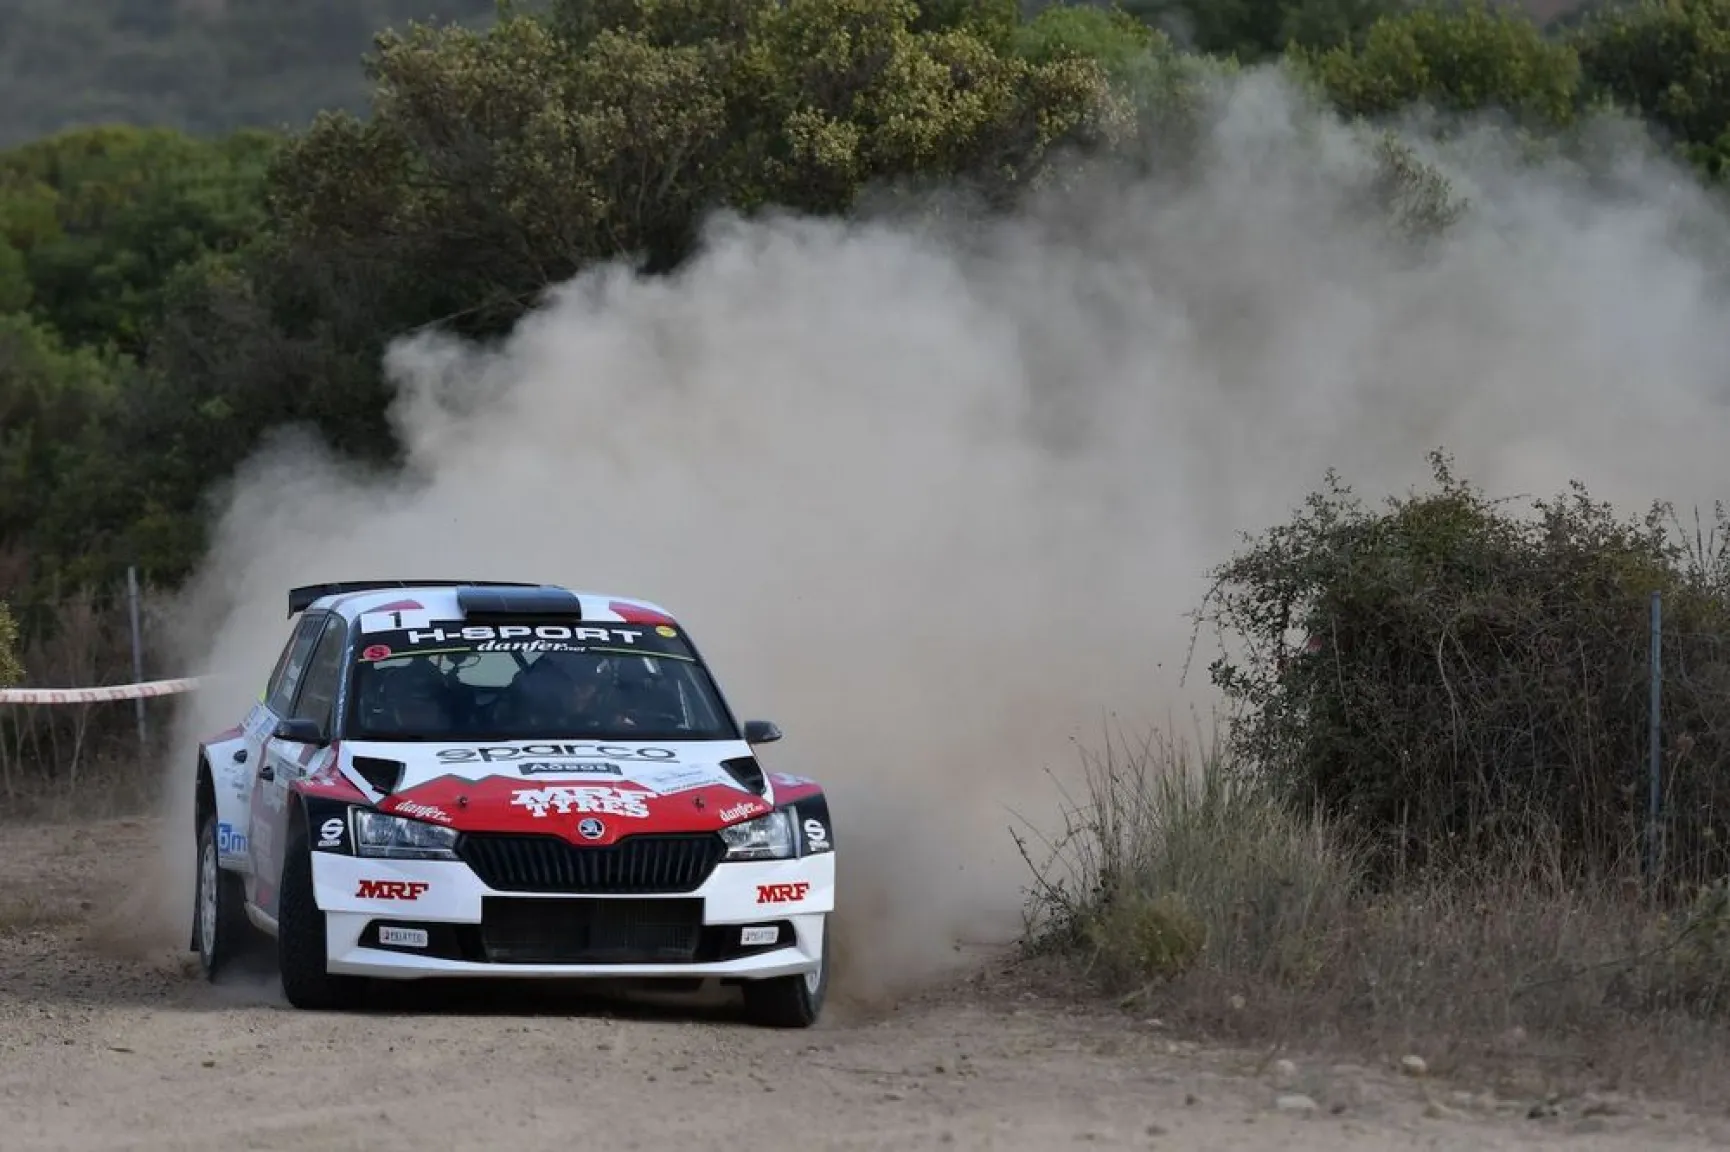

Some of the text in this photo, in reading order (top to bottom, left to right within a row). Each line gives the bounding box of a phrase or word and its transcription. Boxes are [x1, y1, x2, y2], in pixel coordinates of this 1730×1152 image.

[388, 611, 402, 628] 1
[408, 626, 642, 644] H-SPORT
[436, 743, 680, 765] sparco
[510, 786, 659, 805] MRF
[525, 800, 650, 818] TYRES
[355, 880, 429, 900] MRF
[755, 882, 811, 903] MRF
